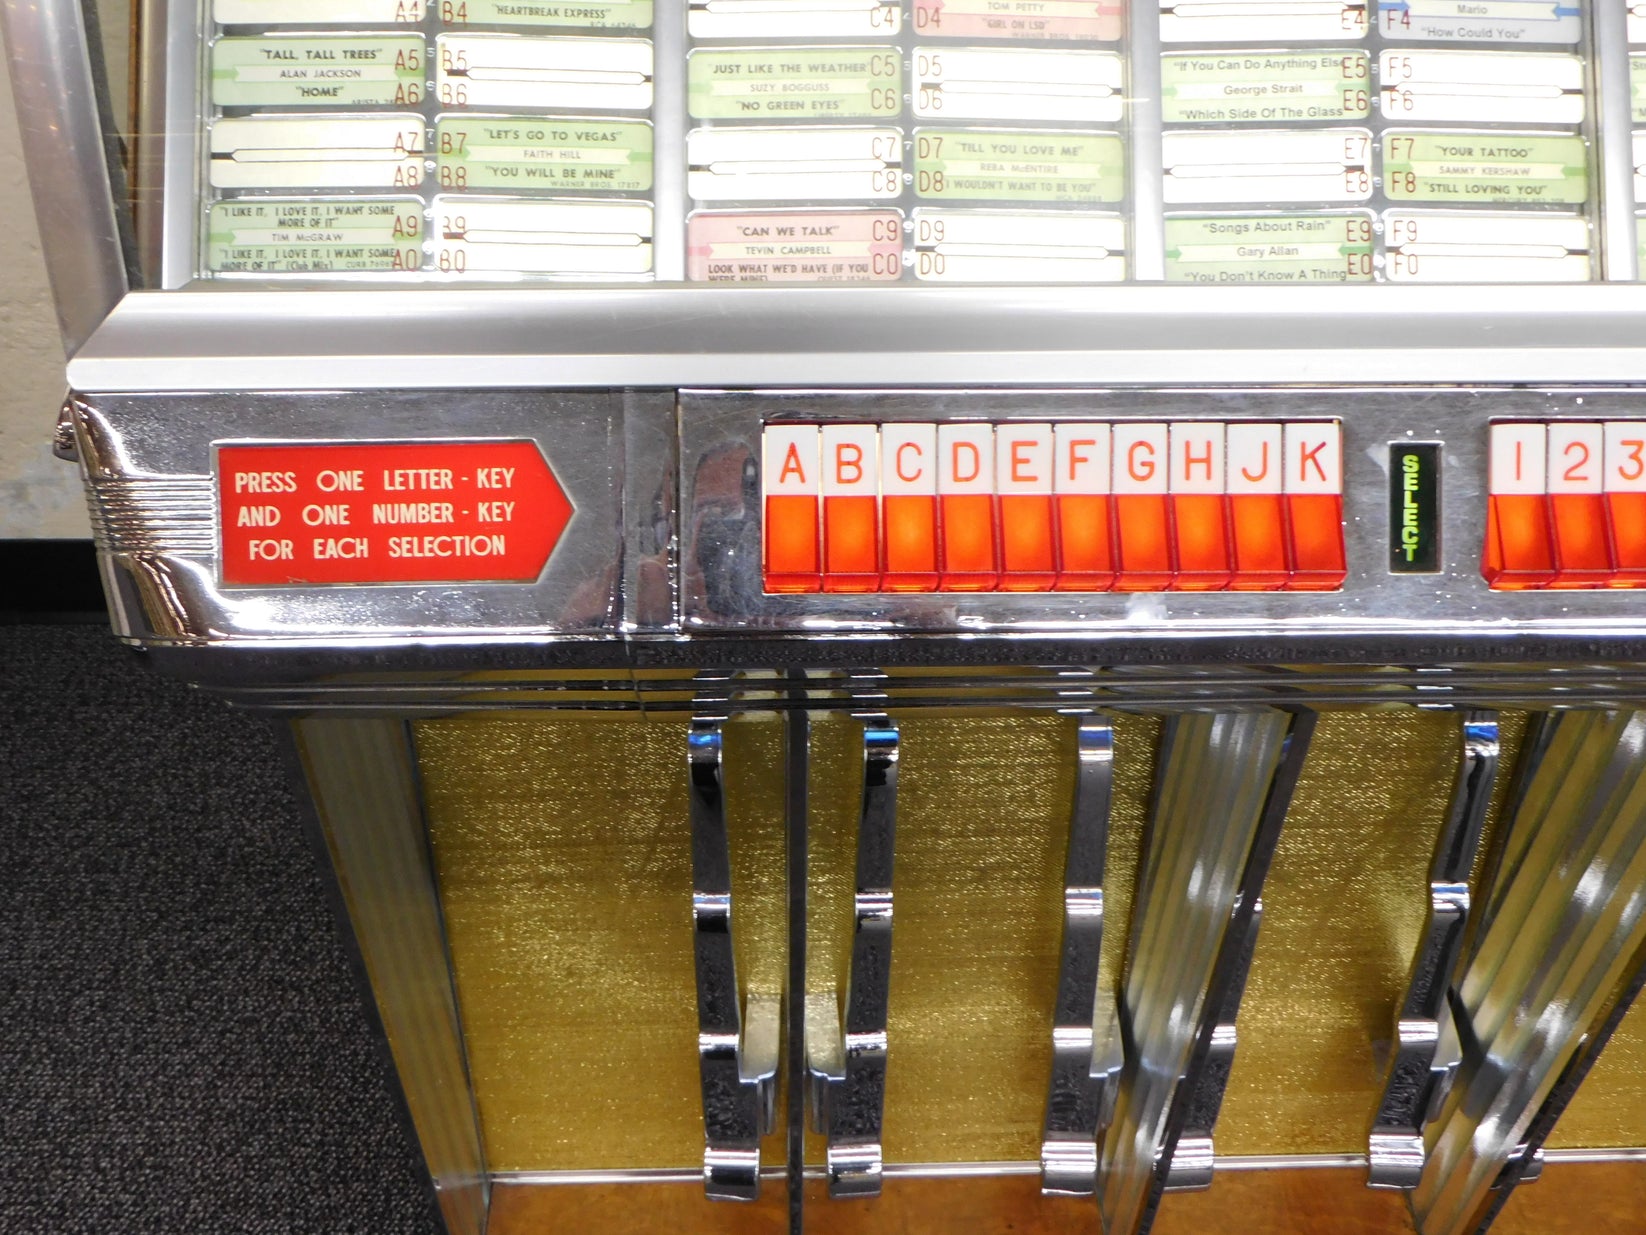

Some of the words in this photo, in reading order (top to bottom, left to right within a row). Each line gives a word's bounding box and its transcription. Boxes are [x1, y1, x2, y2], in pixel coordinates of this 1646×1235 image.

[442, 1, 468, 26] B4
[870, 7, 894, 28] C4
[916, 7, 942, 28] D4
[988, 2, 1009, 10] TOM
[1016, 3, 1044, 12] PETTY
[1457, 5, 1488, 14] Mario
[1012, 20, 1025, 28] ON
[1388, 9, 1410, 30] F4
[1458, 28, 1492, 38] Could
[306, 50, 336, 60] TALL
[394, 49, 419, 70] A5
[442, 50, 468, 71] B5
[870, 54, 896, 76] C5
[1191, 61, 1214, 71] You
[1220, 60, 1240, 70] Can
[1244, 60, 1260, 70] Do
[1264, 59, 1316, 71] Anything
[280, 70, 307, 78] ALAN
[314, 70, 361, 78] JACKSON
[748, 64, 773, 74] LIKE
[780, 64, 801, 73] THE
[1342, 57, 1366, 78] E5
[394, 83, 420, 106] A6
[442, 84, 468, 107] B6
[750, 83, 776, 92] SUZY
[782, 82, 830, 92] BOGGUSS
[1224, 86, 1267, 96] George
[1272, 84, 1303, 94] Strait
[767, 100, 804, 110] GREEN
[871, 88, 896, 110] C6
[1343, 90, 1368, 111] E6
[1230, 108, 1256, 118] Side
[1262, 108, 1276, 118] Of
[1280, 108, 1303, 118] The
[1307, 107, 1343, 118] Glass
[394, 132, 418, 153] A7
[441, 132, 467, 154] B7
[526, 131, 544, 140] GO
[552, 132, 568, 141] TO
[523, 150, 553, 159] FAITH
[560, 151, 582, 160] HILL
[872, 137, 896, 158] C7
[918, 137, 944, 158] D7
[991, 144, 1017, 154] YOU
[1024, 144, 1054, 155] LOVE
[1390, 138, 1414, 160] F7
[394, 166, 419, 189] A8
[440, 166, 468, 190] B8
[526, 168, 555, 178] WILL
[562, 169, 576, 178] BE
[980, 163, 1004, 172] REBA
[1011, 164, 1058, 174] McENTIRE
[1440, 166, 1474, 175] SAMMY
[1482, 167, 1531, 176] KERSHAW
[872, 170, 896, 192] C8
[919, 170, 944, 192] D8
[1008, 182, 1036, 191] WANT
[1041, 182, 1053, 191] TO
[1056, 182, 1068, 192] BE
[1392, 172, 1416, 192] F8
[1466, 184, 1510, 194] LOVING
[232, 208, 252, 216] LIKE
[282, 206, 307, 216] LOVE
[334, 206, 364, 216] WANT
[368, 206, 395, 215] SOME
[278, 218, 305, 228] MORE
[310, 218, 321, 228] OF
[392, 216, 418, 237] A9
[776, 226, 795, 236] WE
[872, 220, 898, 242] C9
[1254, 222, 1292, 232] About
[1346, 220, 1371, 242] E9
[296, 233, 344, 242] McGRAW
[282, 250, 307, 258] LOVE
[334, 249, 364, 258] WANT
[392, 249, 418, 272] A0
[746, 247, 774, 255] TEVIN
[780, 246, 832, 255] CAMPBELL
[1237, 247, 1264, 258] Gary
[1268, 246, 1299, 256] Allan
[708, 264, 734, 274] LOOK
[738, 264, 768, 274] WHAT
[802, 264, 828, 274] HAVE
[848, 264, 869, 273] YOU
[873, 253, 898, 275] C0
[1348, 254, 1372, 275] E0
[1258, 270, 1294, 280] Know
[1298, 270, 1308, 280] A
[1312, 269, 1346, 281] Thing
[780, 442, 806, 484] A
[836, 443, 862, 484] B
[896, 442, 922, 482] C
[952, 442, 980, 482] D
[1012, 441, 1038, 482] E
[1069, 440, 1096, 480] F
[1127, 441, 1155, 481] G
[1185, 440, 1212, 480] H
[1242, 441, 1268, 482] J
[1300, 441, 1326, 481] K
[1563, 442, 1590, 480] 2
[1618, 440, 1644, 480] 3
[235, 472, 297, 493] PRESS
[316, 470, 364, 492] ONE
[384, 469, 452, 490] LETTER
[477, 468, 515, 488] KEY
[238, 506, 281, 527] AND
[302, 504, 350, 526] ONE
[373, 503, 454, 524] NUMBER
[478, 502, 515, 522] KEY
[1402, 454, 1419, 562] SELECT
[250, 539, 294, 560] FOR
[314, 538, 369, 559] EACH
[388, 536, 505, 558] SELECTION
